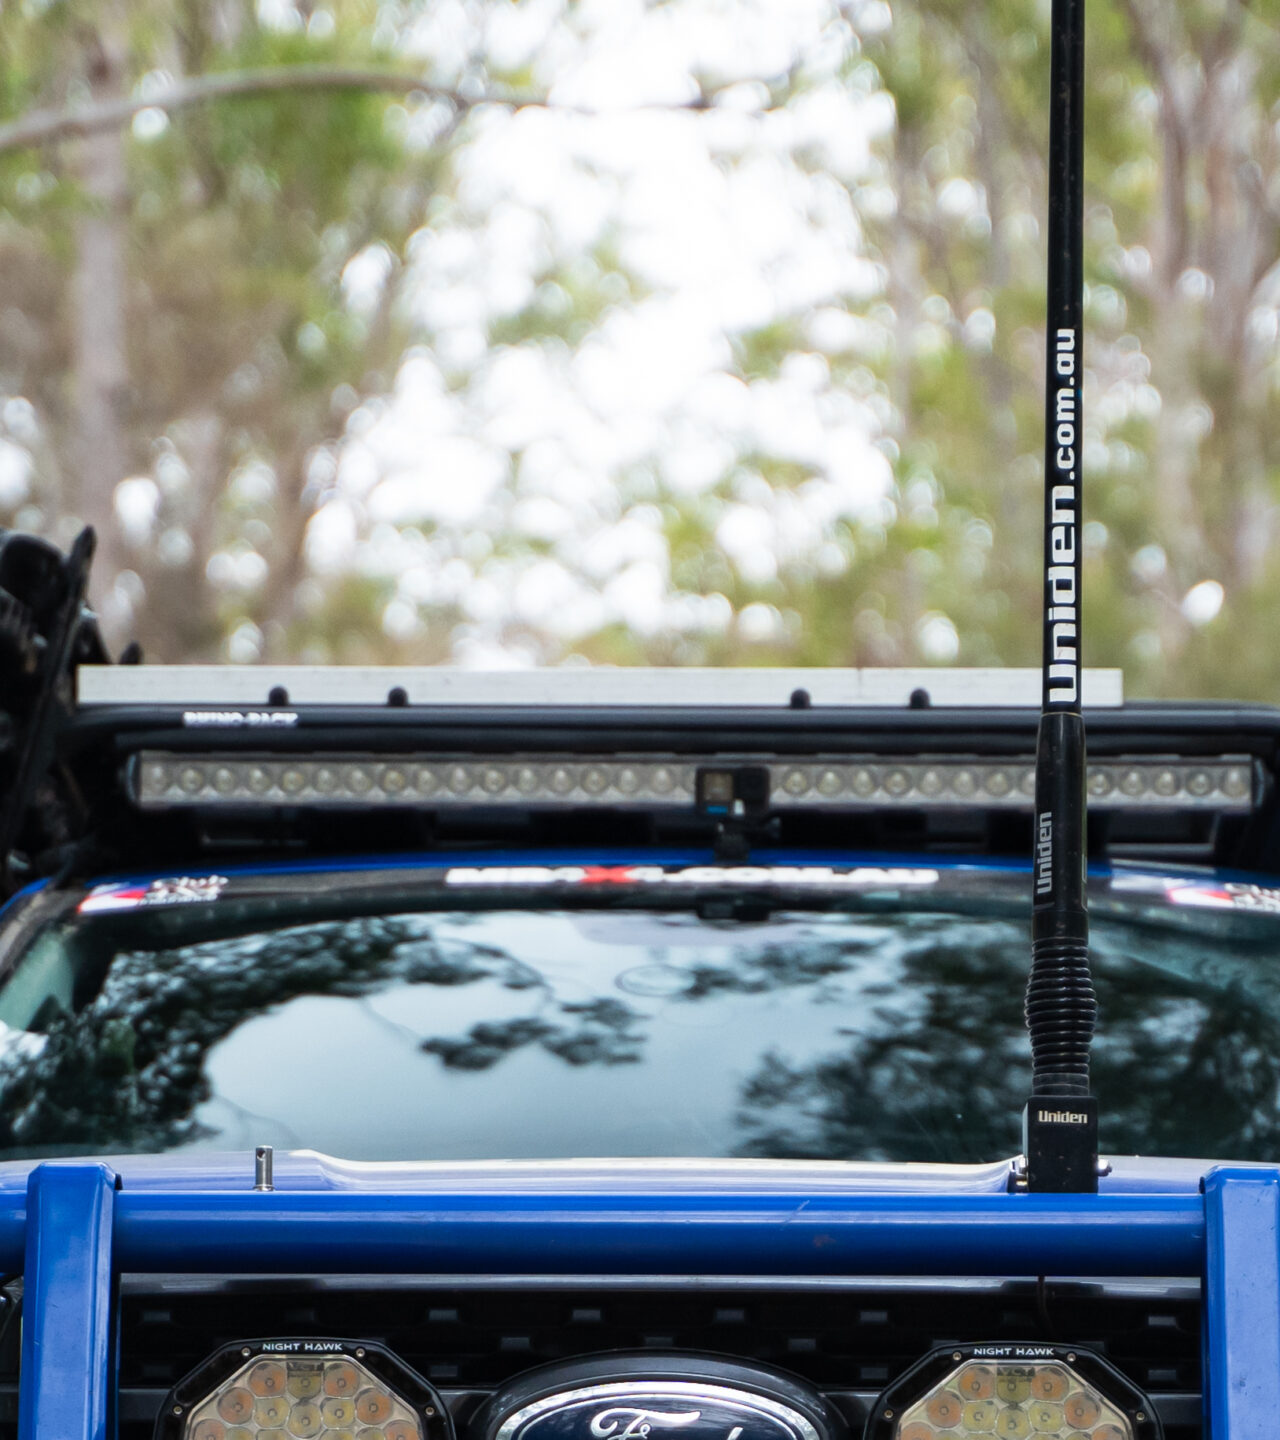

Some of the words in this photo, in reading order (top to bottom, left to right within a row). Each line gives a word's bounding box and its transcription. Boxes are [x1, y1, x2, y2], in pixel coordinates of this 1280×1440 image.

[1037, 811, 1052, 894] Uniden
[1038, 1110, 1088, 1124] Uniden
[1015, 1348, 1054, 1356] HAWK
